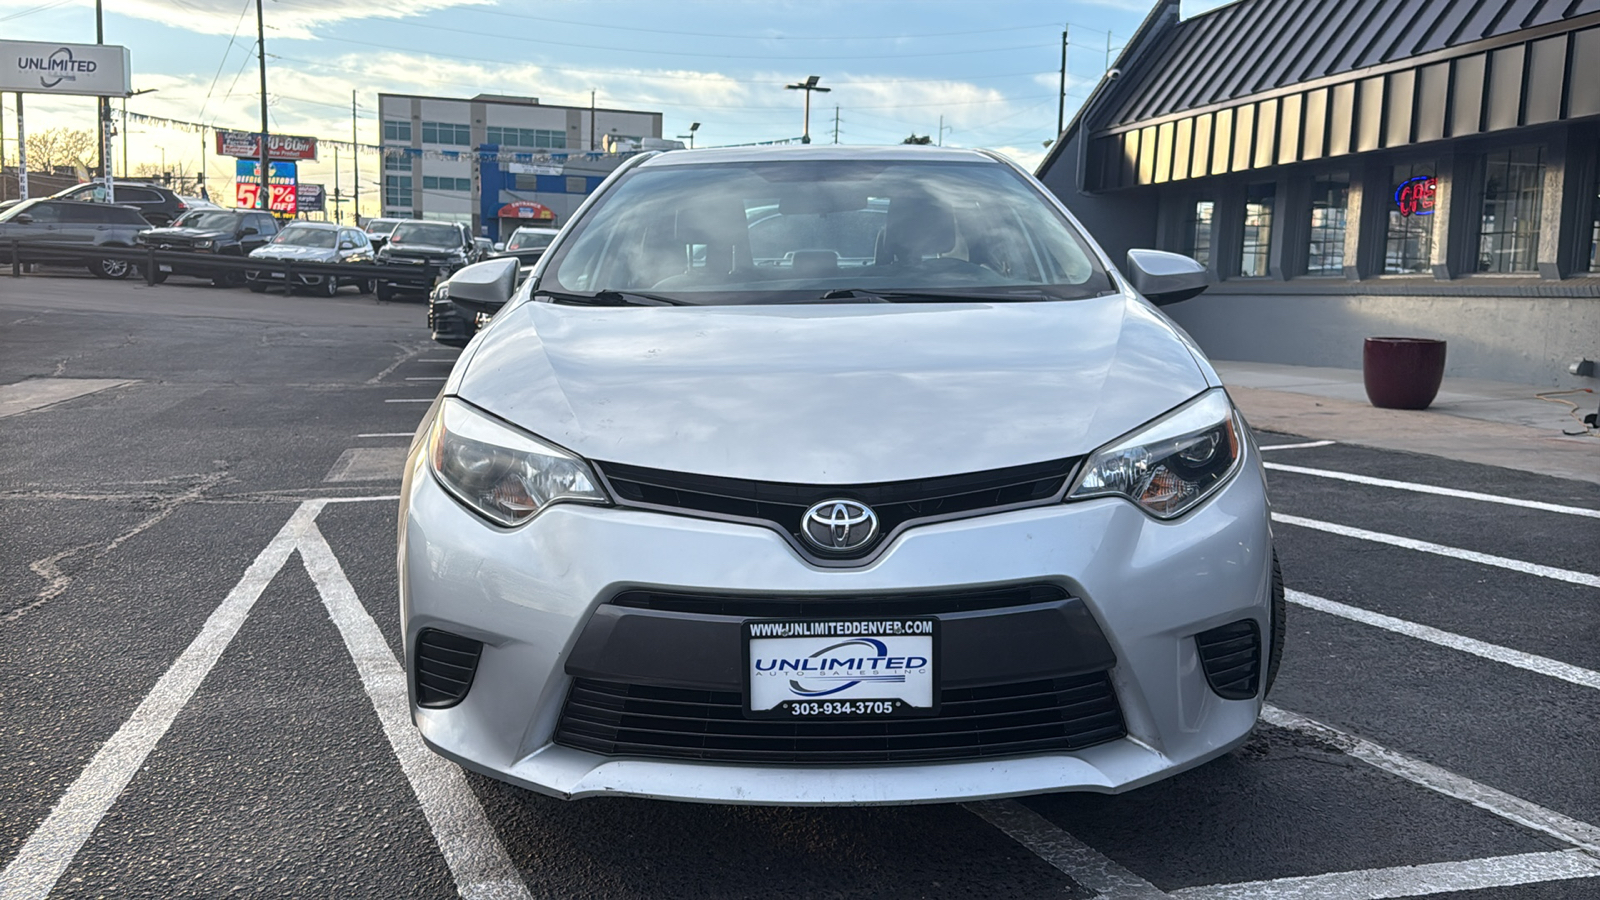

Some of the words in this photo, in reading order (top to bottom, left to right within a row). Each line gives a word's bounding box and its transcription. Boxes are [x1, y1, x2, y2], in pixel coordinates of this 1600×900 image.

[18, 57, 97, 73] UNLIMITED
[267, 136, 301, 151] 0-60
[1400, 177, 1438, 216] OPE
[272, 203, 295, 211] OFF
[511, 201, 541, 209] ENTRANCE
[750, 621, 933, 637] WWWUNLIMITEDDENVER.COM
[755, 657, 928, 671] UNLIMITED
[791, 702, 893, 716] 303-934-3705
